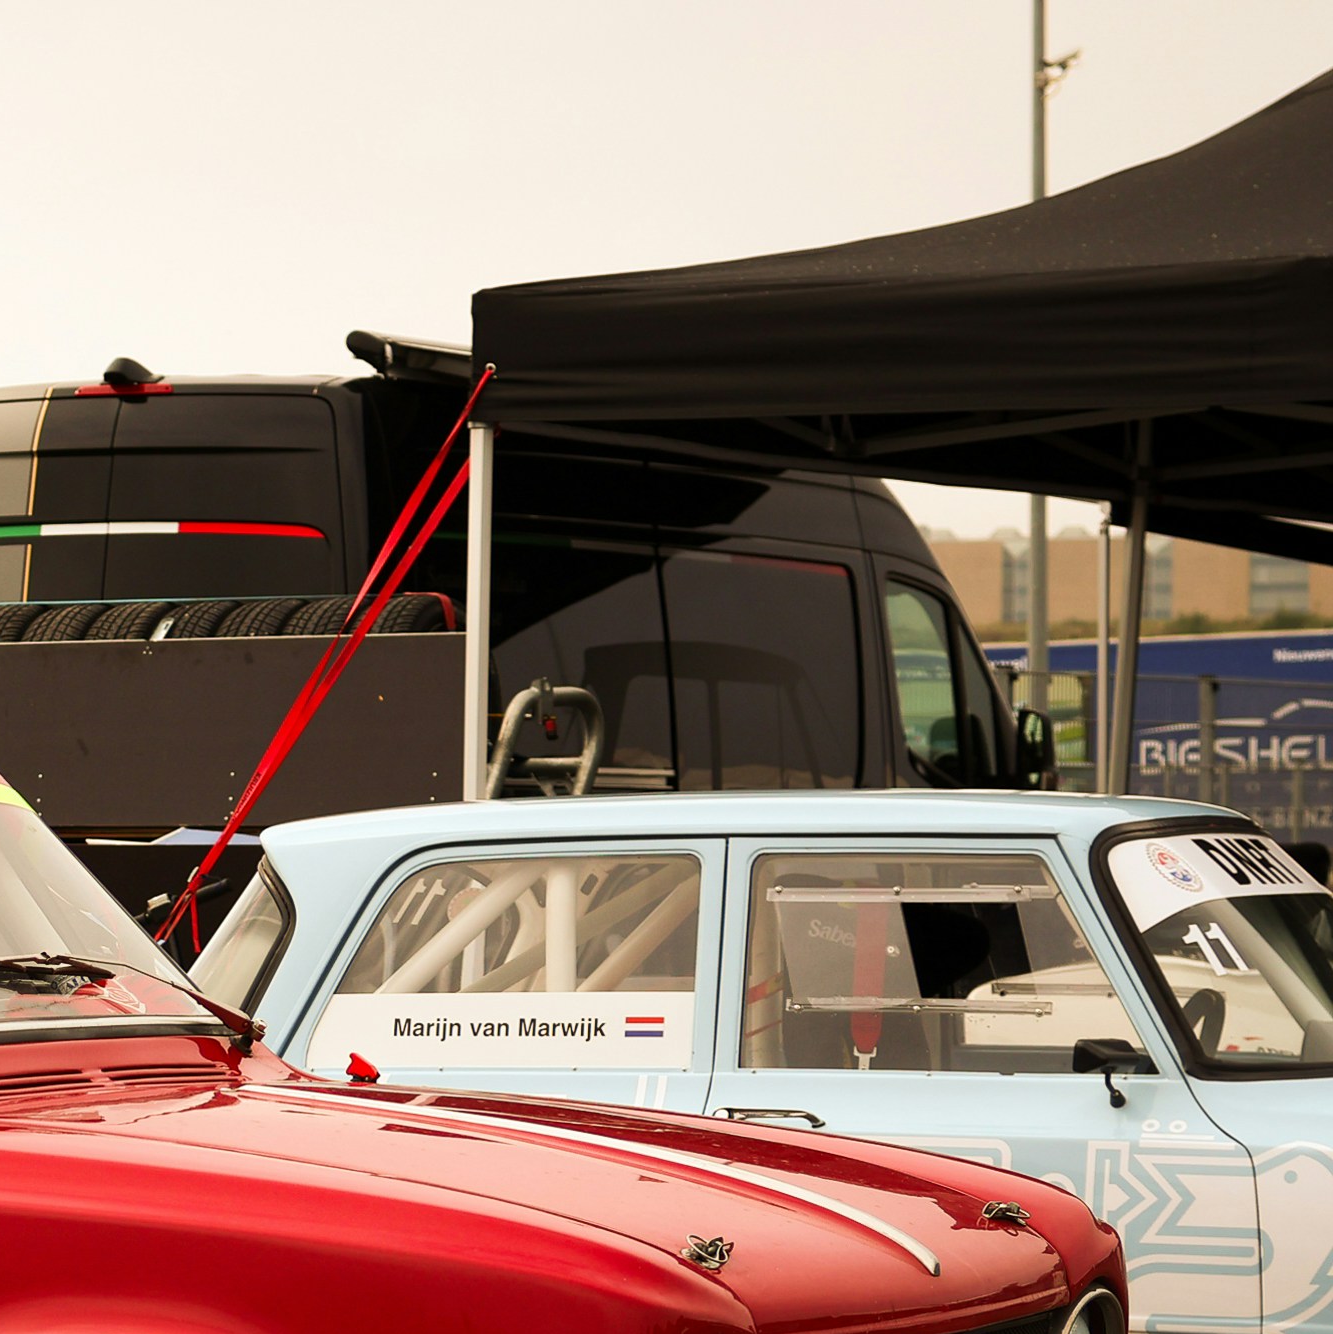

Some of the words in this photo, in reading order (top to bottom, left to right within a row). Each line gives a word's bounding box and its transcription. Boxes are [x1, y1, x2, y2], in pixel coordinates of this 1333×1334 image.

[1182, 922, 1249, 977] 11
[393, 1017, 462, 1043] Marijn
[469, 1022, 511, 1039] van
[518, 1017, 606, 1043] Marwijk
